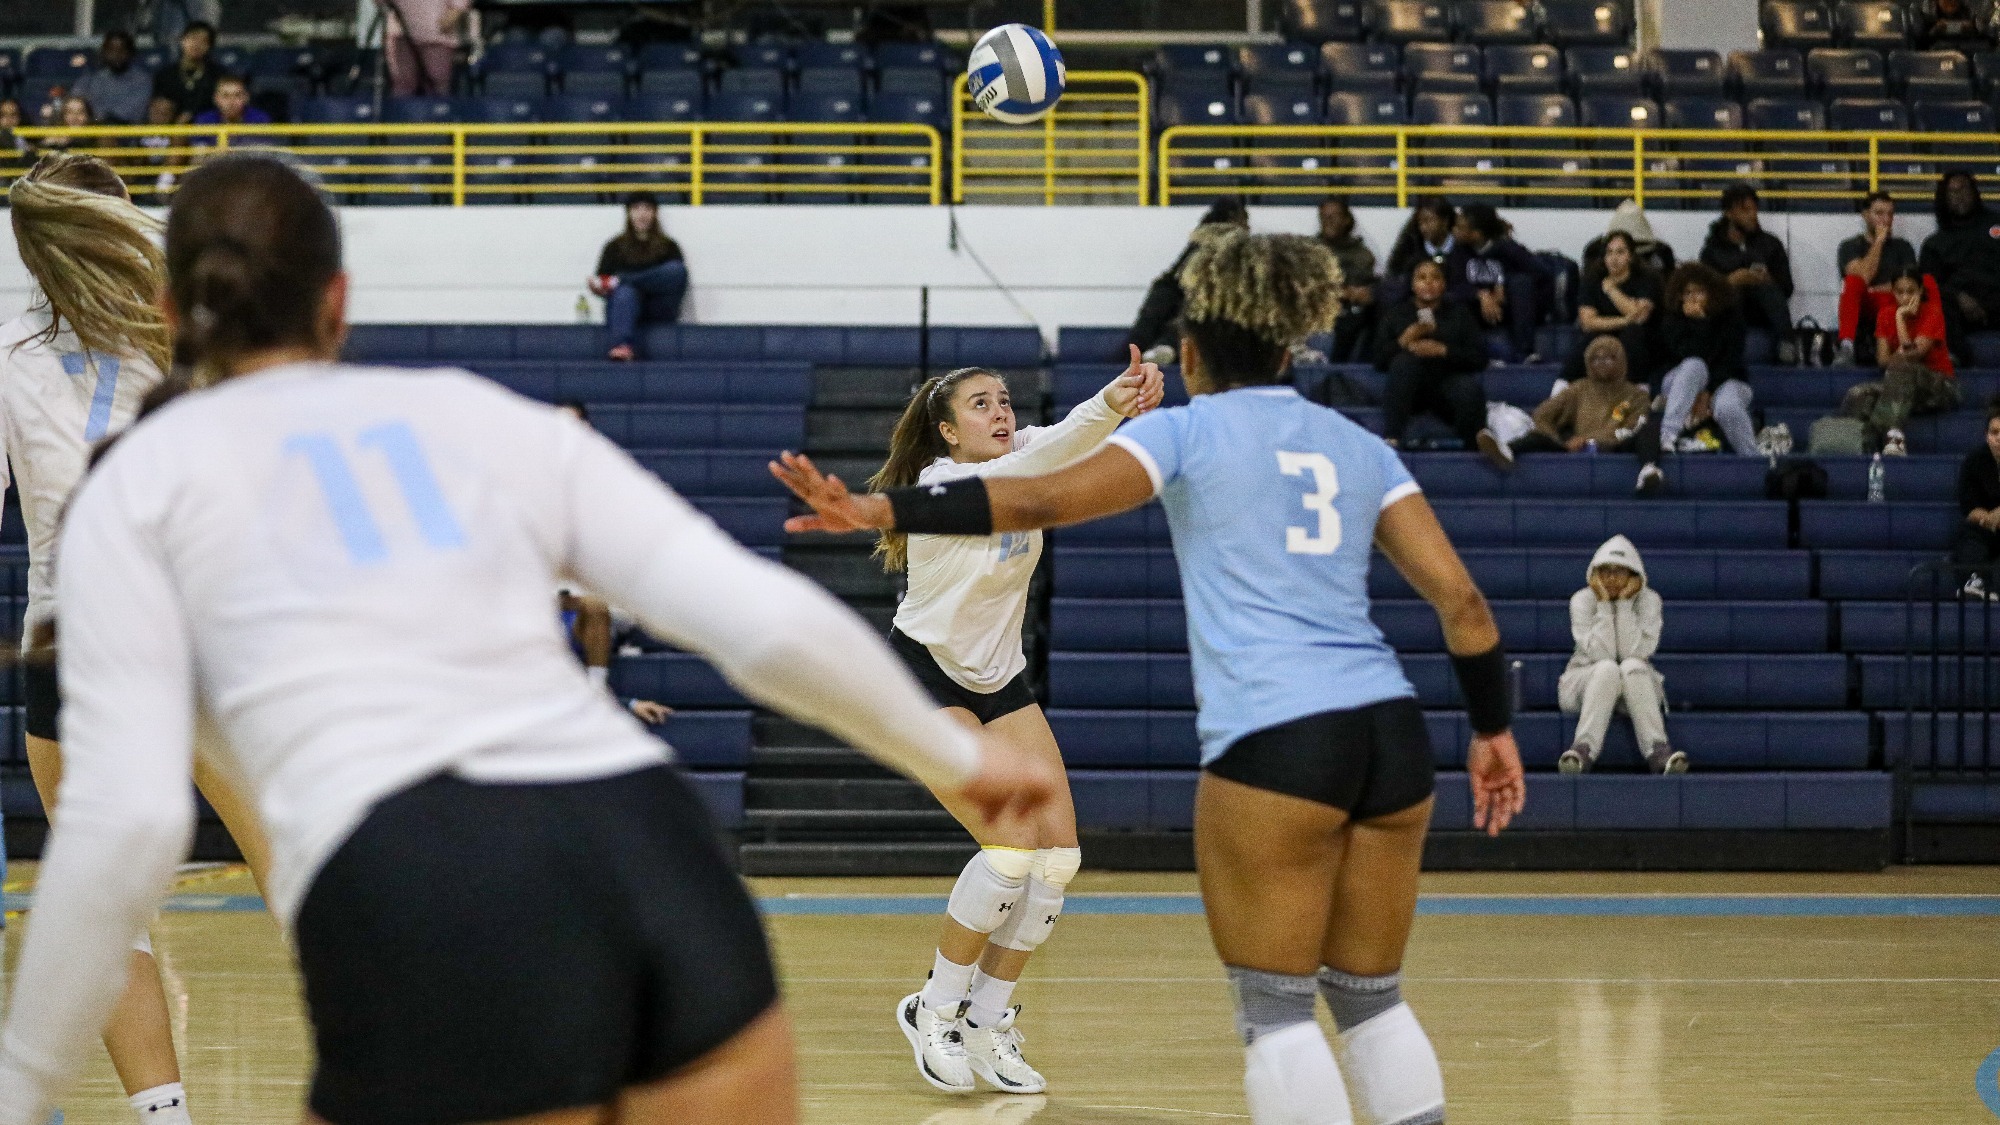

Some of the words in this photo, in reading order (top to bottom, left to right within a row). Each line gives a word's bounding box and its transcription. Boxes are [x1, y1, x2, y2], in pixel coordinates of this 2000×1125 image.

[61, 351, 121, 442] 7
[284, 421, 468, 563] 11
[1276, 450, 1341, 554] 3
